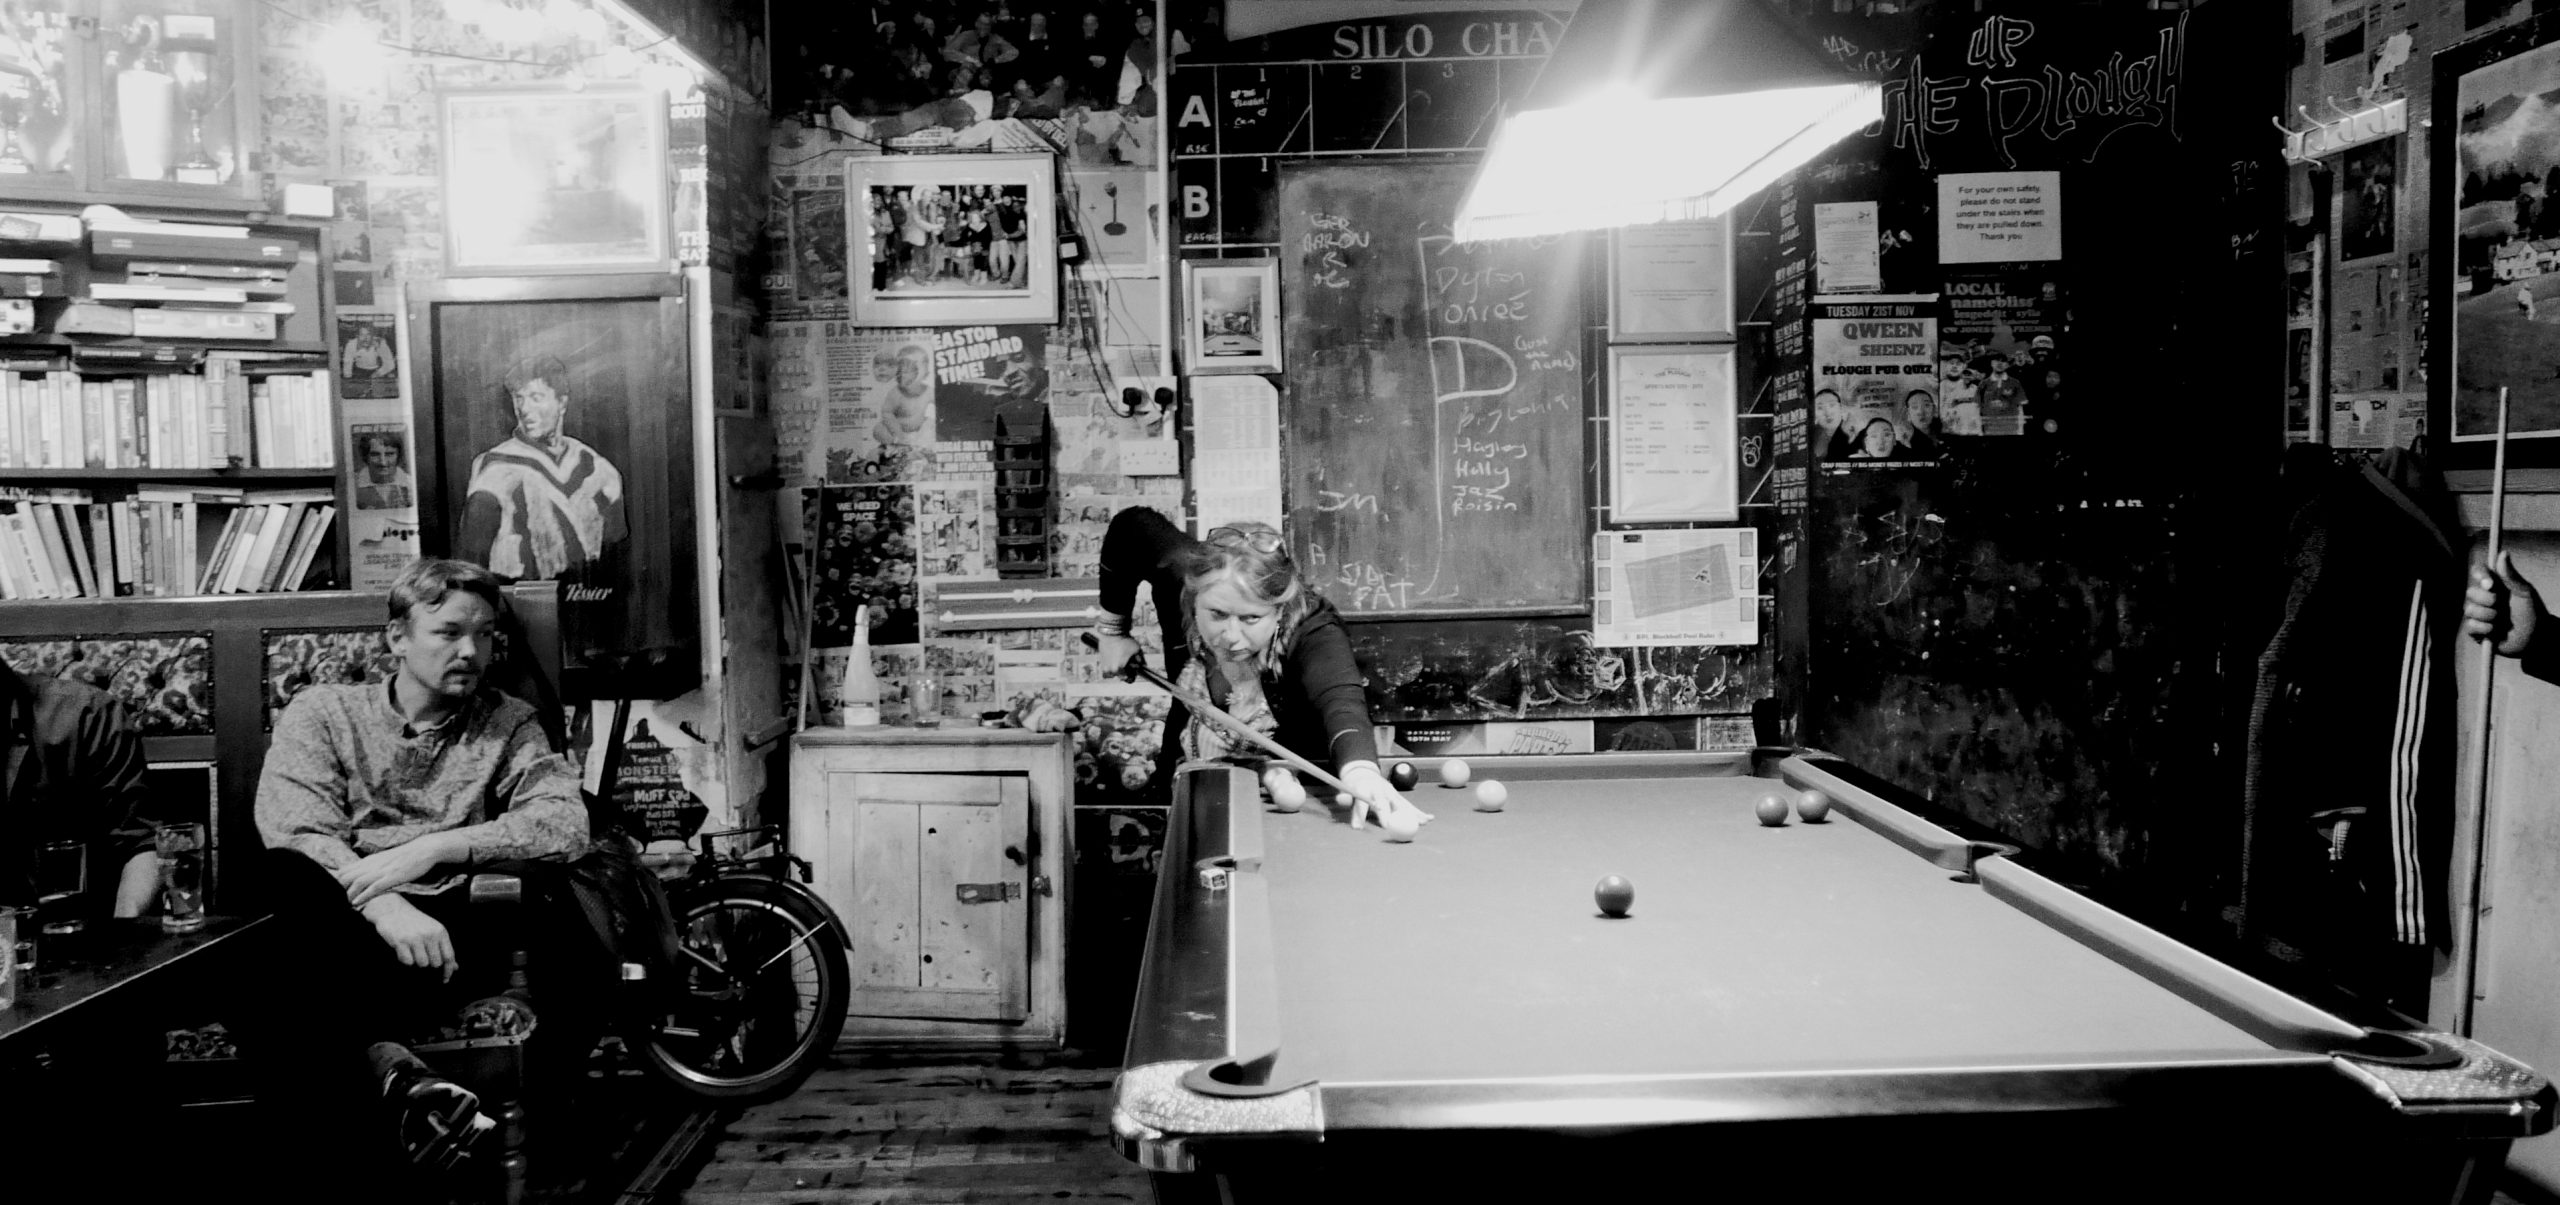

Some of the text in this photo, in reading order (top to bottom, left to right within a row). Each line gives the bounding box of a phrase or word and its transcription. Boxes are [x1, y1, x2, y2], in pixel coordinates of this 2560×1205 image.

[1333, 24, 1434, 58] SILO
[1967, 15, 2034, 69] UP
[1259, 63, 1455, 82] 1 2 3
[1178, 95, 1212, 128] A
[1260, 157, 1268, 172] 1
[1958, 186, 1973, 194] For
[1975, 187, 1994, 195] your
[1183, 185, 1211, 218] B
[1960, 198, 1987, 207] please
[1990, 197, 2000, 205] do
[1956, 223, 1975, 231] they
[1992, 221, 2018, 229] pulled
[1980, 232, 2023, 242] Thank you
[1944, 282, 2005, 296] LOCAL
[1826, 305, 1915, 318] TUESDAY 21ST NOV
[1843, 322, 1925, 340] QWEEN
[932, 326, 998, 351] EASTON
[935, 336, 1023, 368] STANDARD
[1860, 343, 1926, 356] SHEENZ
[937, 361, 986, 386] TIME!
[1822, 364, 1933, 375] PLOUGH PUB QUIZ
[836, 501, 881, 511] WE NEED
[842, 511, 877, 521] SPACE
[626, 742, 658, 750] FRIDAY
